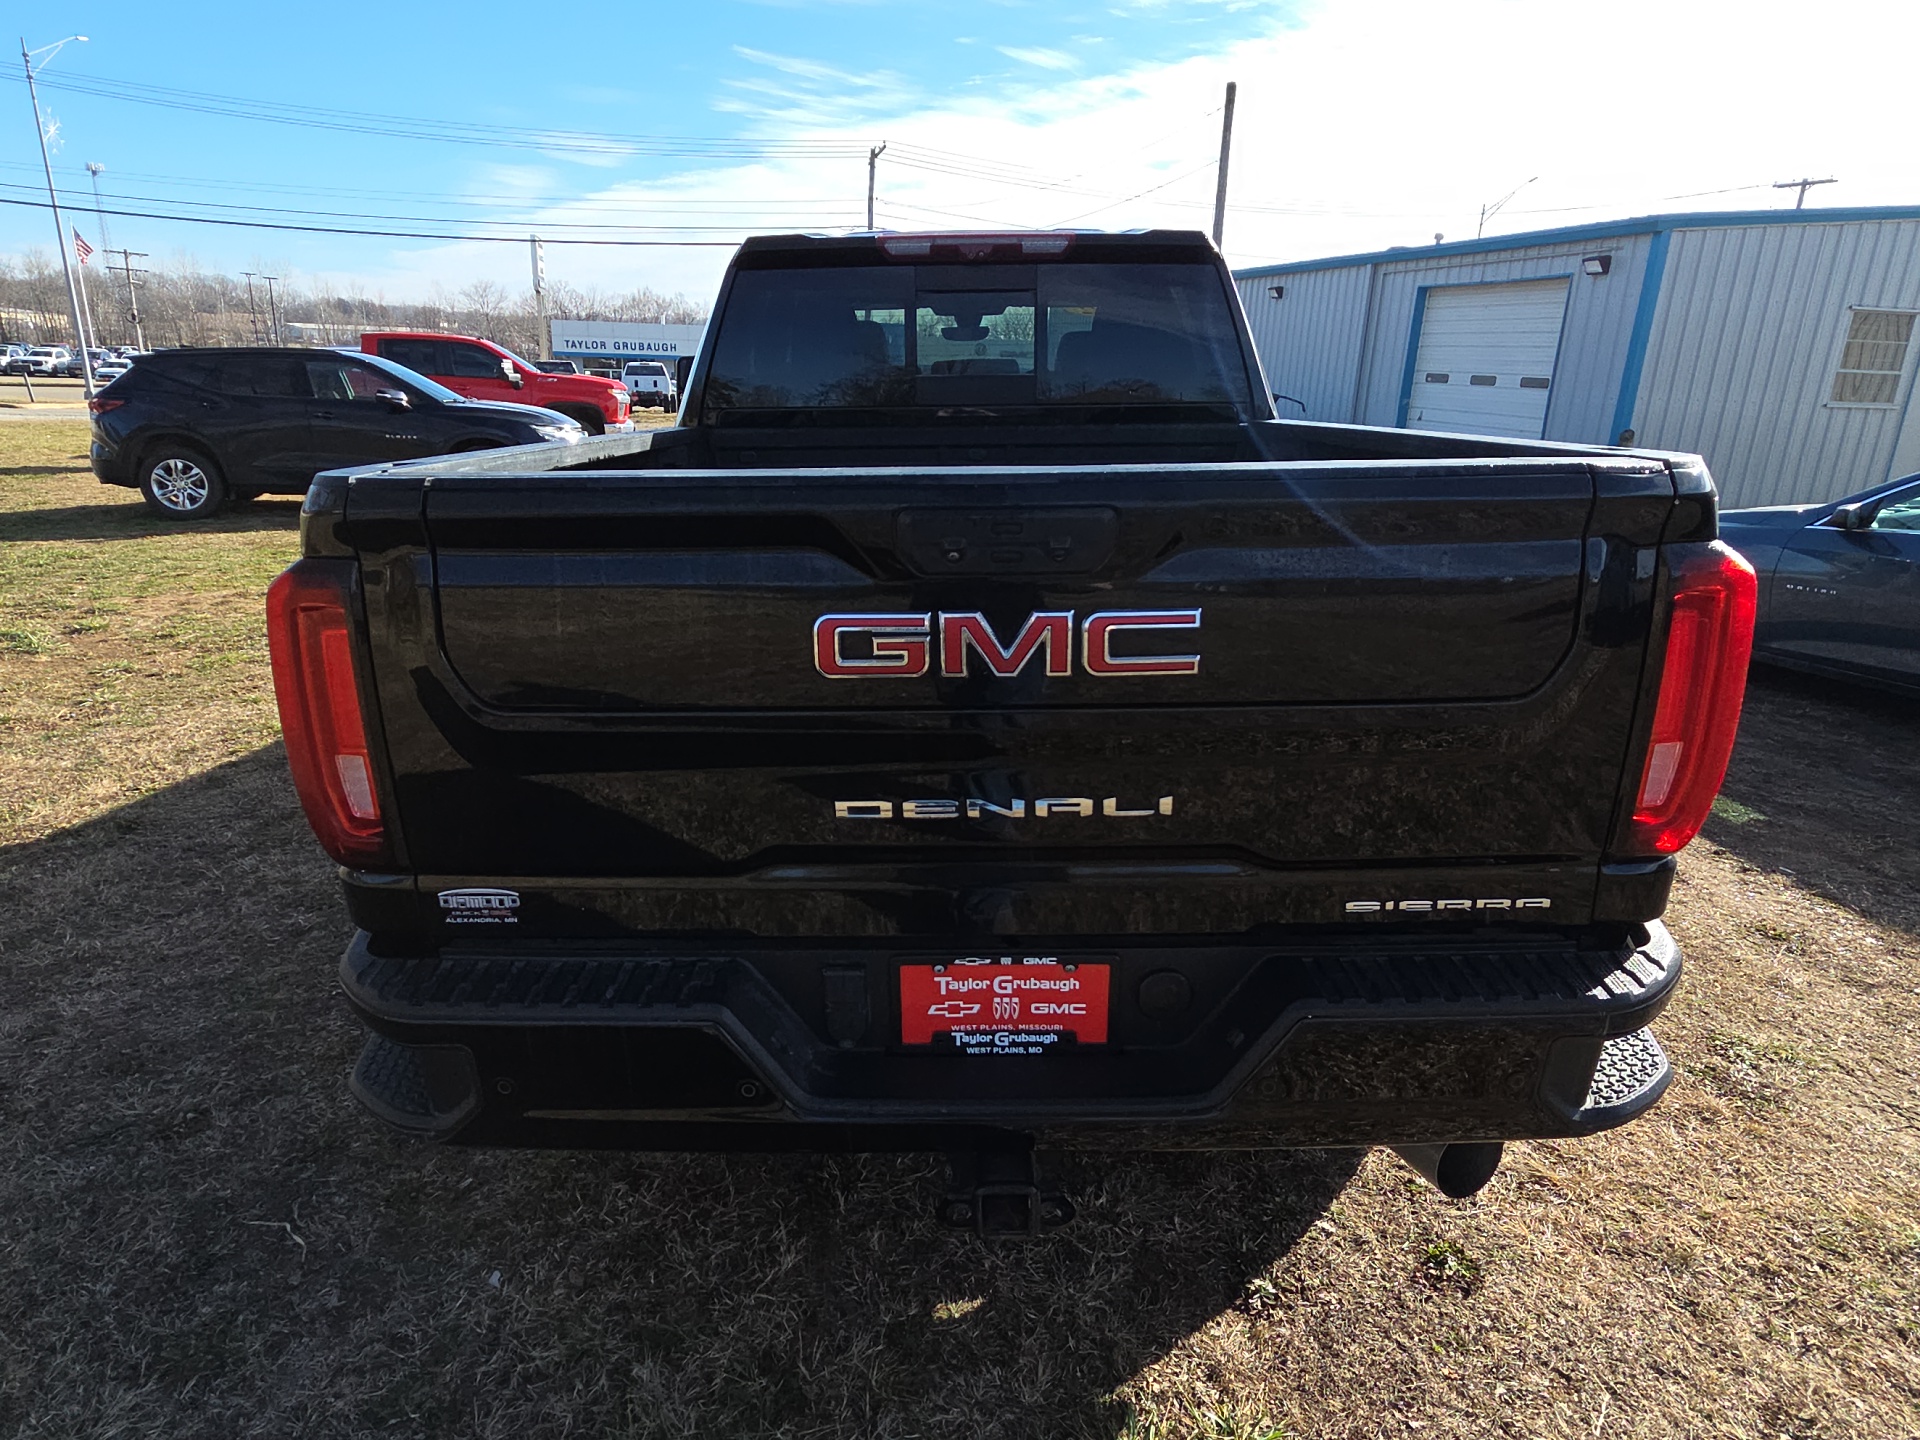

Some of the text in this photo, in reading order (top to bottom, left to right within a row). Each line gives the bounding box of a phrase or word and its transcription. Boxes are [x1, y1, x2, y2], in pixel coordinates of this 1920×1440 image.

[563, 339, 677, 352] TAYLOR GRUBAUGH
[813, 607, 1202, 678] GMC
[834, 795, 1173, 819] DENALI
[1345, 897, 1551, 912] SIERRA
[1023, 957, 1058, 965] GMC
[933, 975, 1080, 995] Taylor Grubaugh
[1030, 1003, 1087, 1015] GMC
[1018, 1023, 1064, 1031] MISSOURI
[951, 1031, 1058, 1046] Taylor Grubaugh
[966, 1046, 1043, 1055] WEST PLAINS, MO
